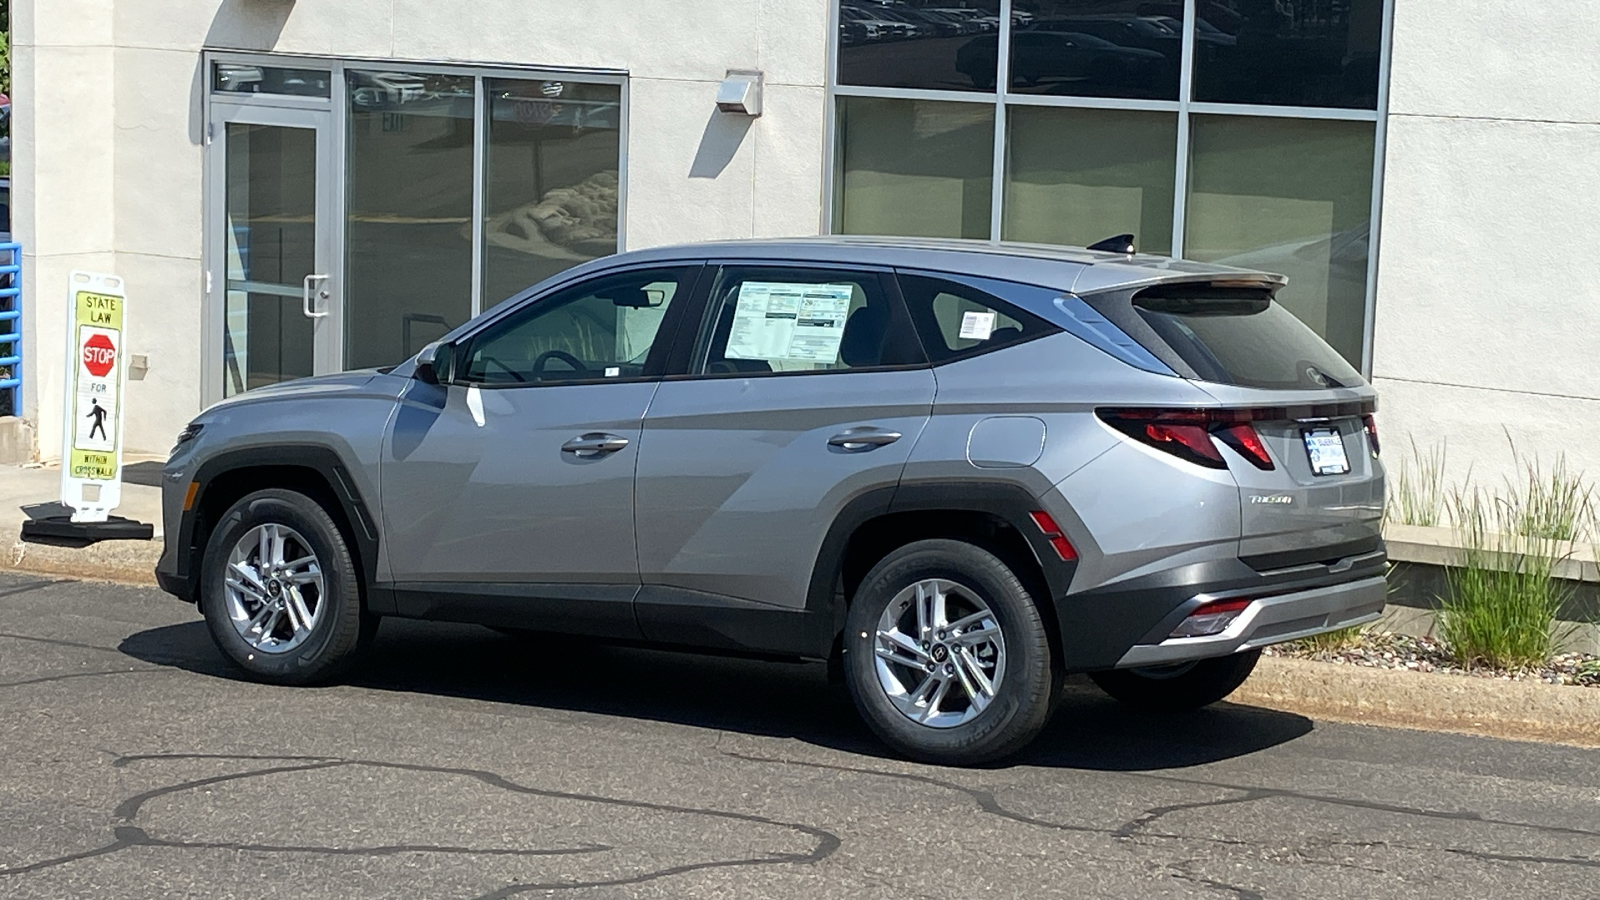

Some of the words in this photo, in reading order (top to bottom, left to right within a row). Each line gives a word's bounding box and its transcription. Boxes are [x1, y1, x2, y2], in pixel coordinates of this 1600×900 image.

[86, 296, 116, 311] STATE
[90, 310, 112, 324] LAW
[84, 346, 116, 365] STOP
[91, 383, 107, 394] FOR
[84, 454, 108, 465] WITHIN
[75, 465, 113, 477] CROSSWALK
